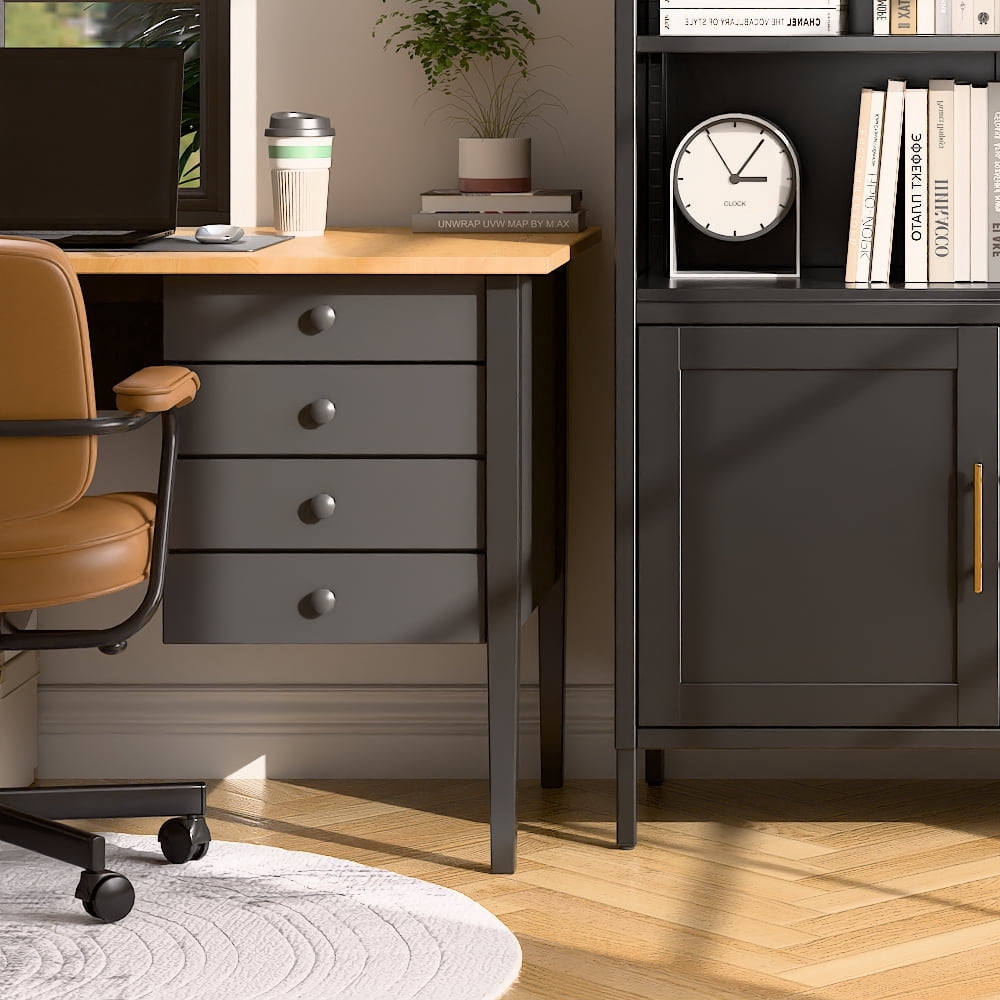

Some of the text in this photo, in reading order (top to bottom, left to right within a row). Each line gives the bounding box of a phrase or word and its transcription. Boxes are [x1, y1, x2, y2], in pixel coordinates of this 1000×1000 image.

[438, 220, 480, 228] UNWRAP
[483, 220, 505, 228] UVW
[508, 220, 529, 228] MAP
[531, 220, 543, 228] BY
